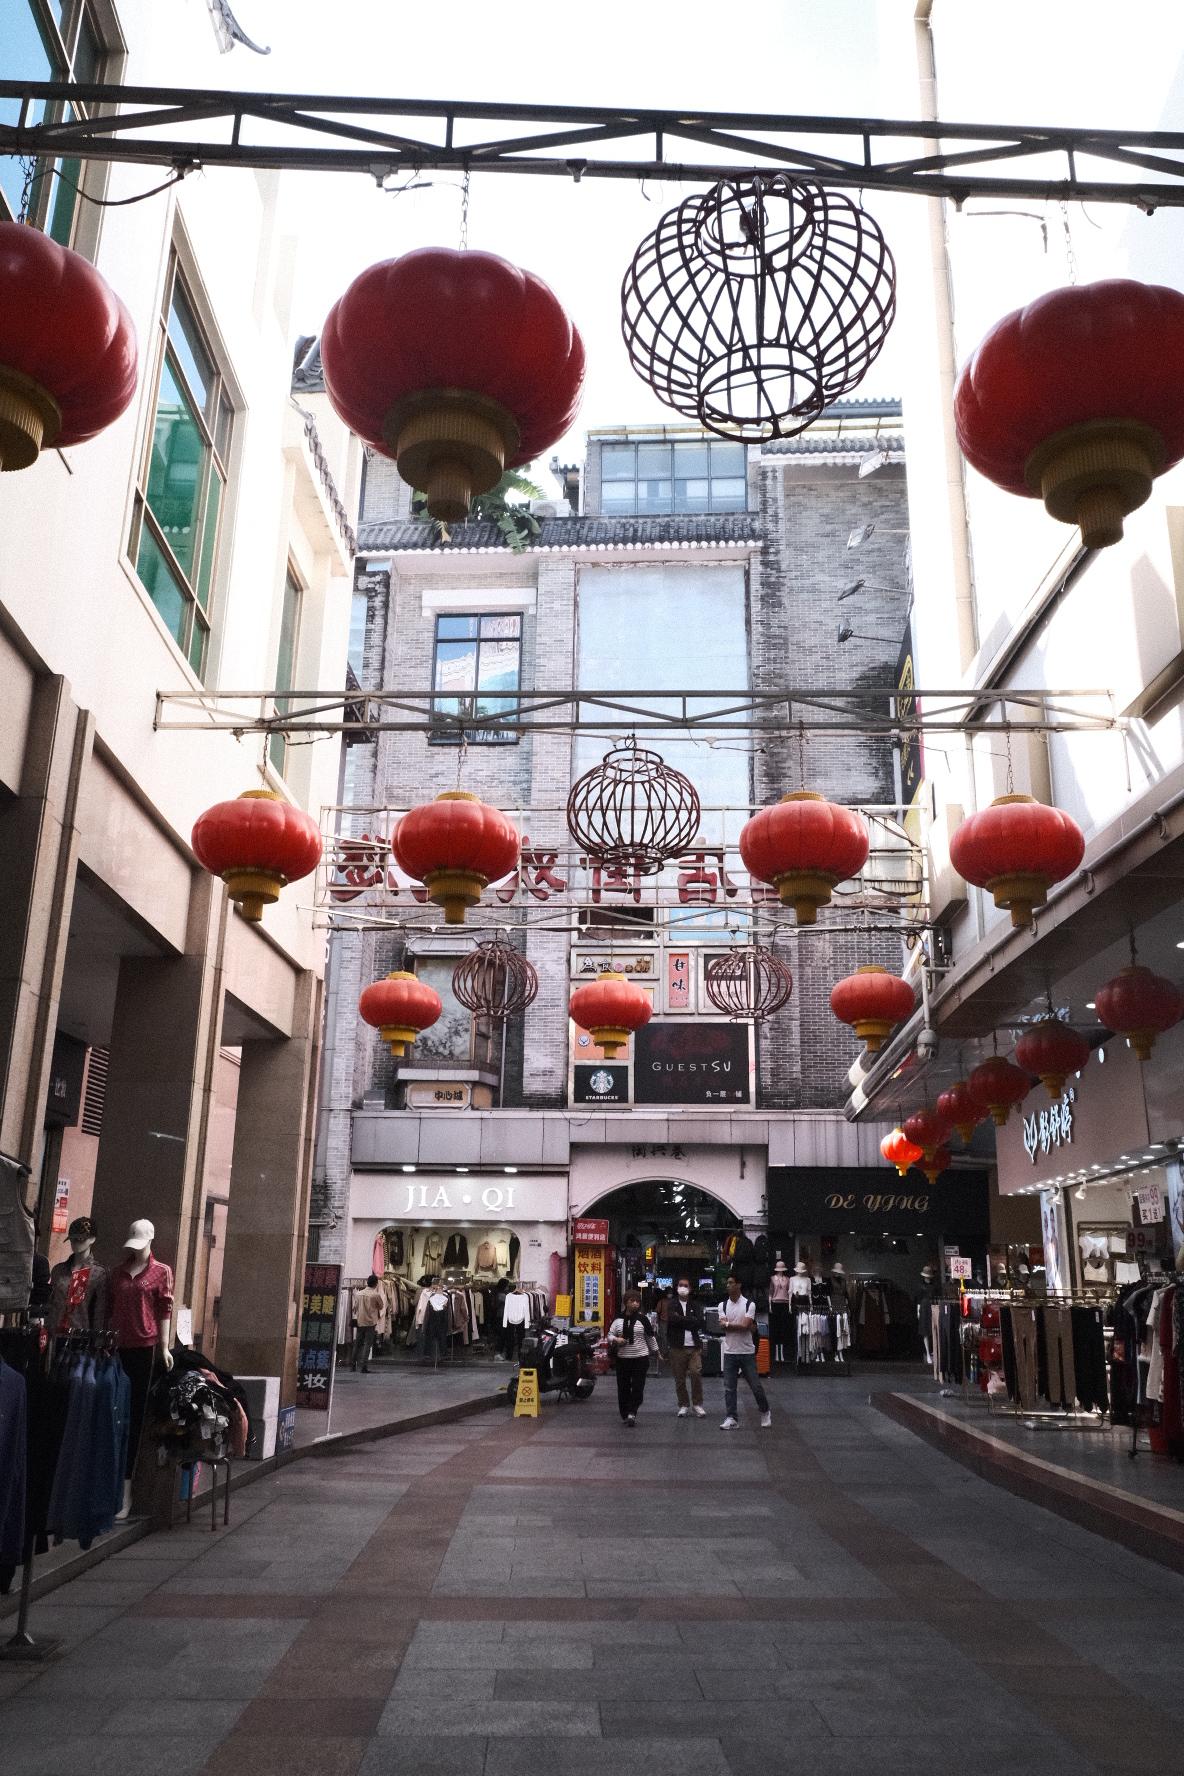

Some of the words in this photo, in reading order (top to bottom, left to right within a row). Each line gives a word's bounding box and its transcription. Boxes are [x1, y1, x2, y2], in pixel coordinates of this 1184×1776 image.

[671, 958, 686, 992] 甘味
[434, 1090, 464, 1101] 中心城
[403, 1185, 452, 1213] JIA
[481, 1186, 516, 1212] QI
[824, 1193, 856, 1209] DE
[863, 1193, 930, 1212] YING
[577, 1261, 602, 1275] 饮料
[296, 1373, 329, 1389] 妆
